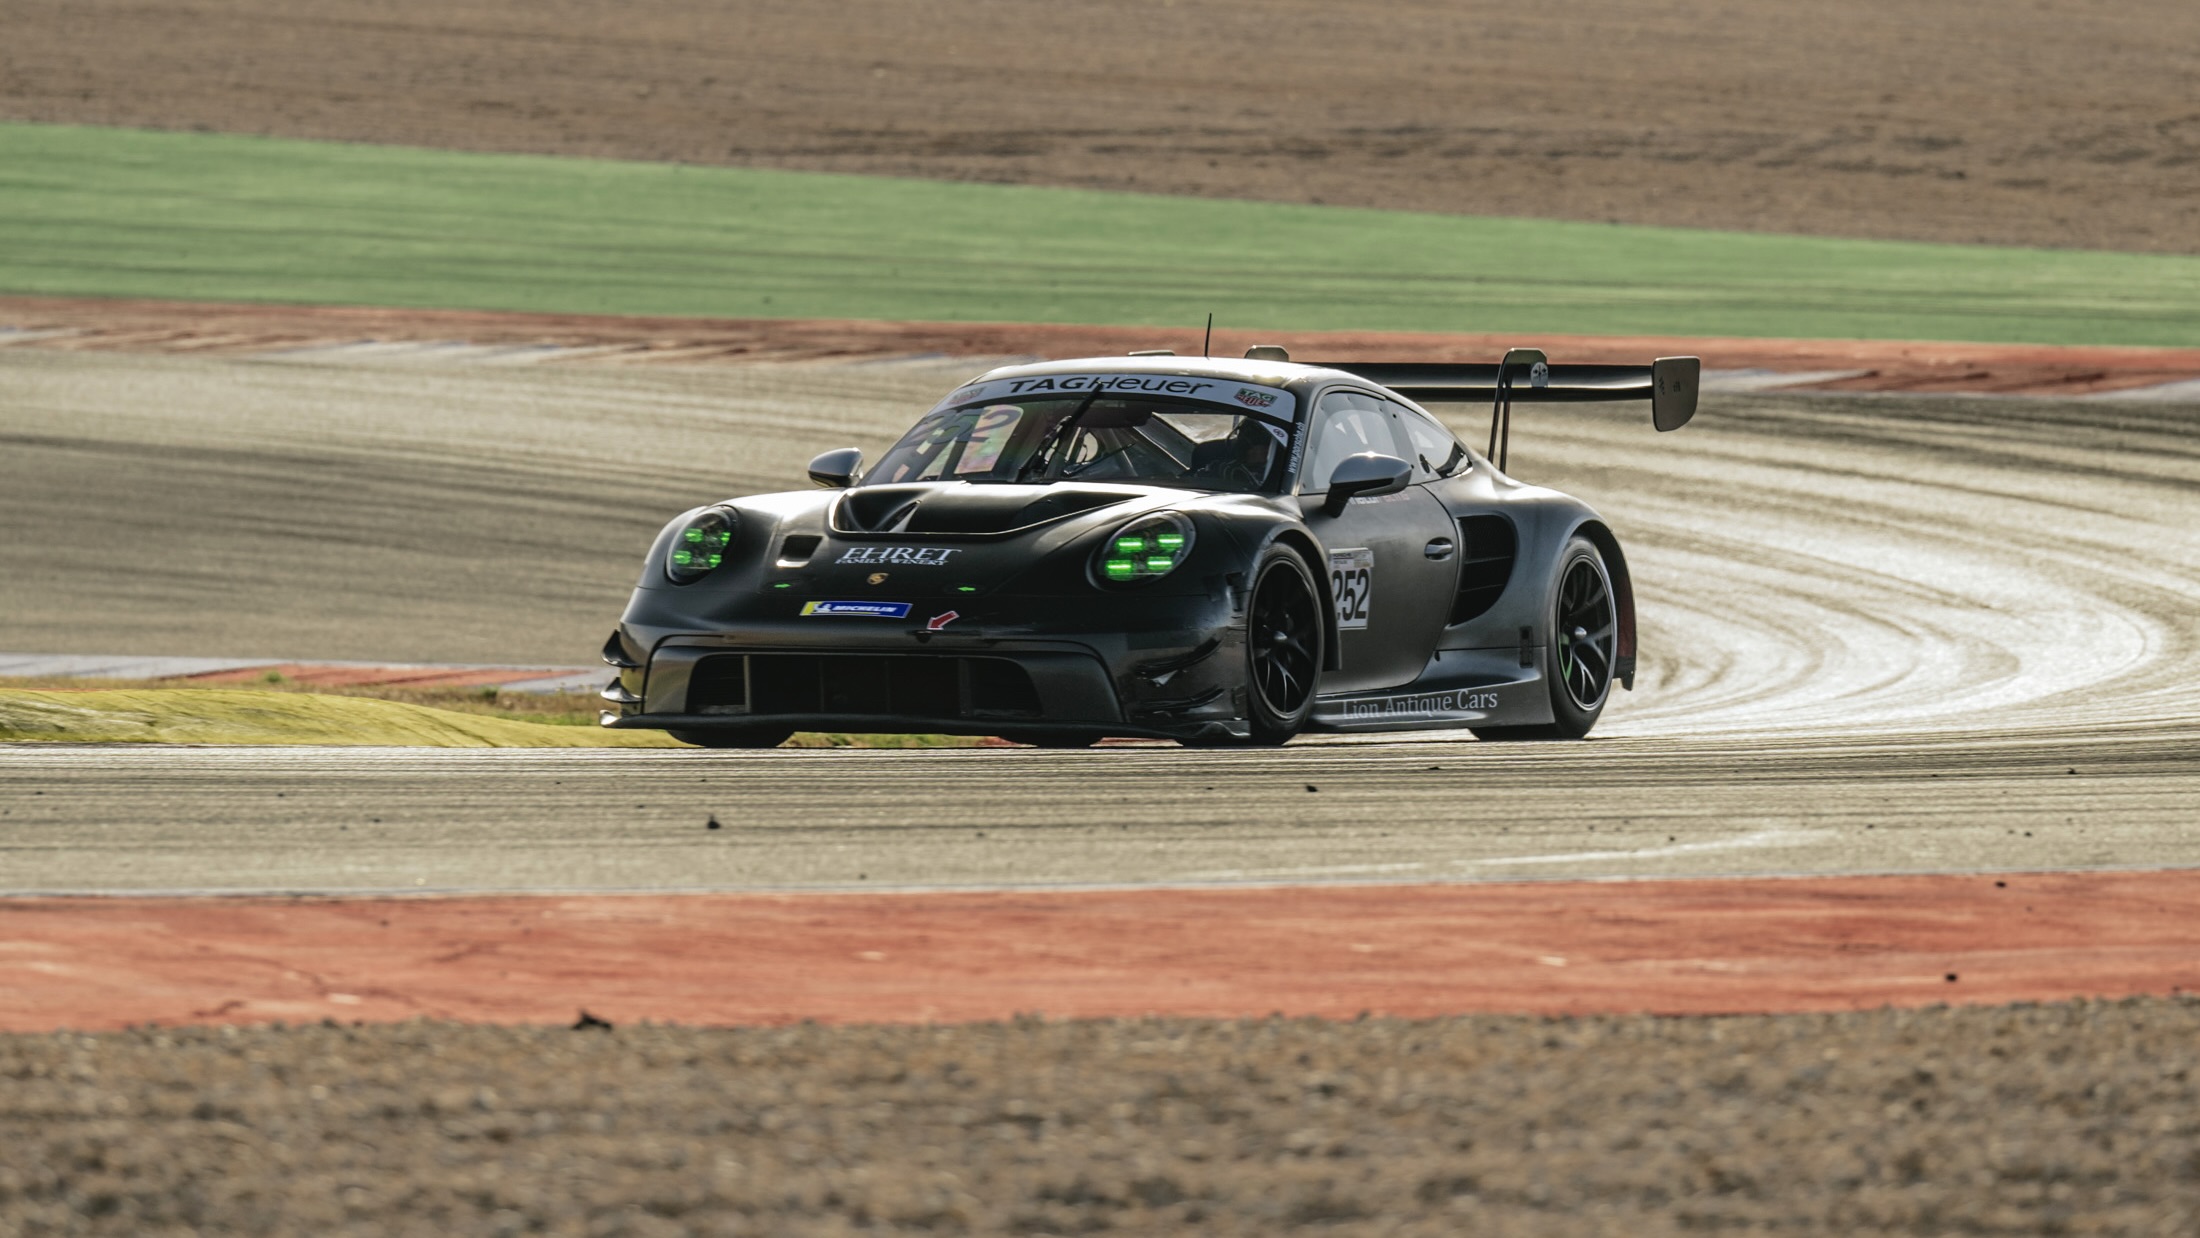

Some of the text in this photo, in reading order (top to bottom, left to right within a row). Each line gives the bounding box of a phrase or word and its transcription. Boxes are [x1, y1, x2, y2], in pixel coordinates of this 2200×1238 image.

[1243, 389, 1273, 401] TAG
[842, 547, 962, 560] EHRET
[890, 558, 949, 566] WINERY
[1332, 568, 1370, 621] 252
[831, 604, 898, 613] MICHELIN
[1343, 688, 1498, 719] Lion Antique Cars
